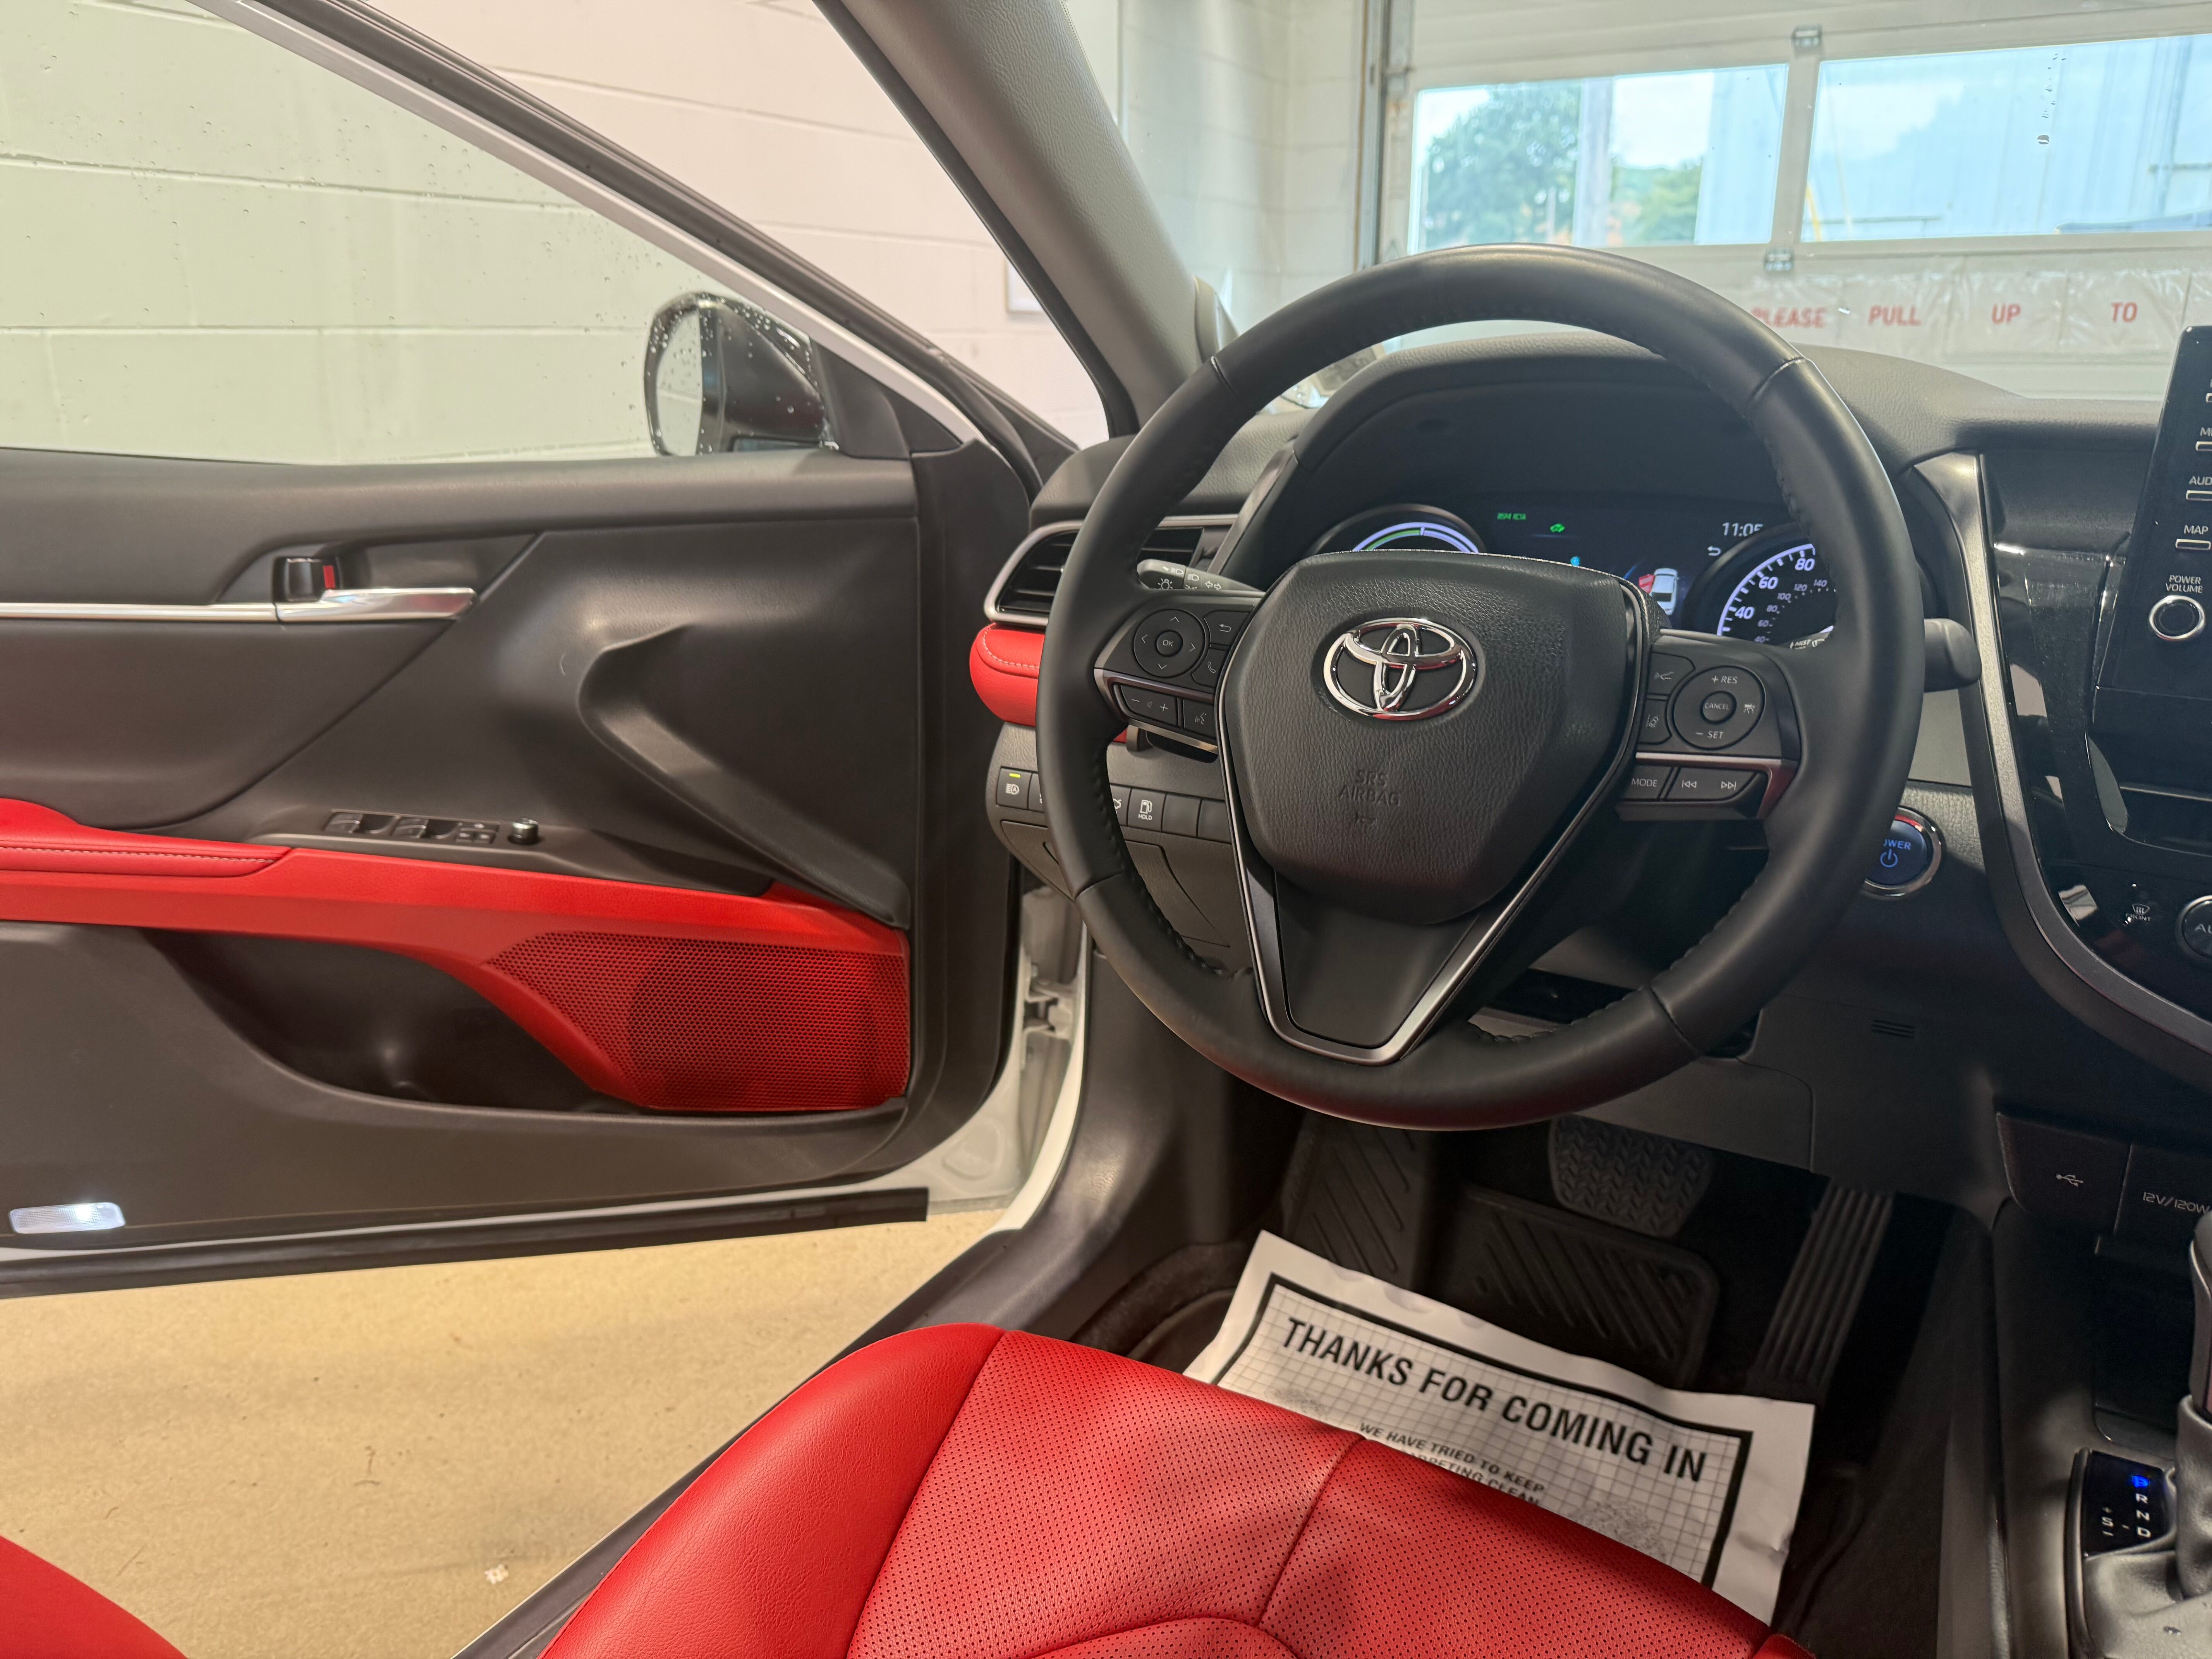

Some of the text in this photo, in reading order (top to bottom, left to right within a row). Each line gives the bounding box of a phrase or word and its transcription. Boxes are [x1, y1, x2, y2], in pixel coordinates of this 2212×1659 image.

[1869, 306, 1922, 326] PULL
[1991, 304, 2021, 325] UP
[2111, 302, 2138, 323] TO
[2184, 525, 2209, 535] MAP
[1795, 558, 1815, 571] 80
[1759, 576, 1779, 589] 60
[1814, 579, 1827, 587] 140
[2169, 575, 2201, 584] POWER
[2166, 582, 2203, 593] VOLUME
[1735, 606, 1755, 620] 40
[1721, 676, 1738, 684] RES
[1708, 731, 1724, 739] SET
[1355, 769, 1388, 787] SRS
[1631, 777, 1658, 787] MODE
[1338, 784, 1401, 807] AIRBAG
[2143, 1192, 2210, 1214] 12V/120W
[1283, 1317, 1707, 1482] THANKS FOR COMING IN
[1360, 1422, 1545, 1493] WE HAVE TRIED TO KEEP
[2135, 1493, 2148, 1504] R
[2136, 1510, 2150, 1521] N
[2137, 1526, 2151, 1538] D
